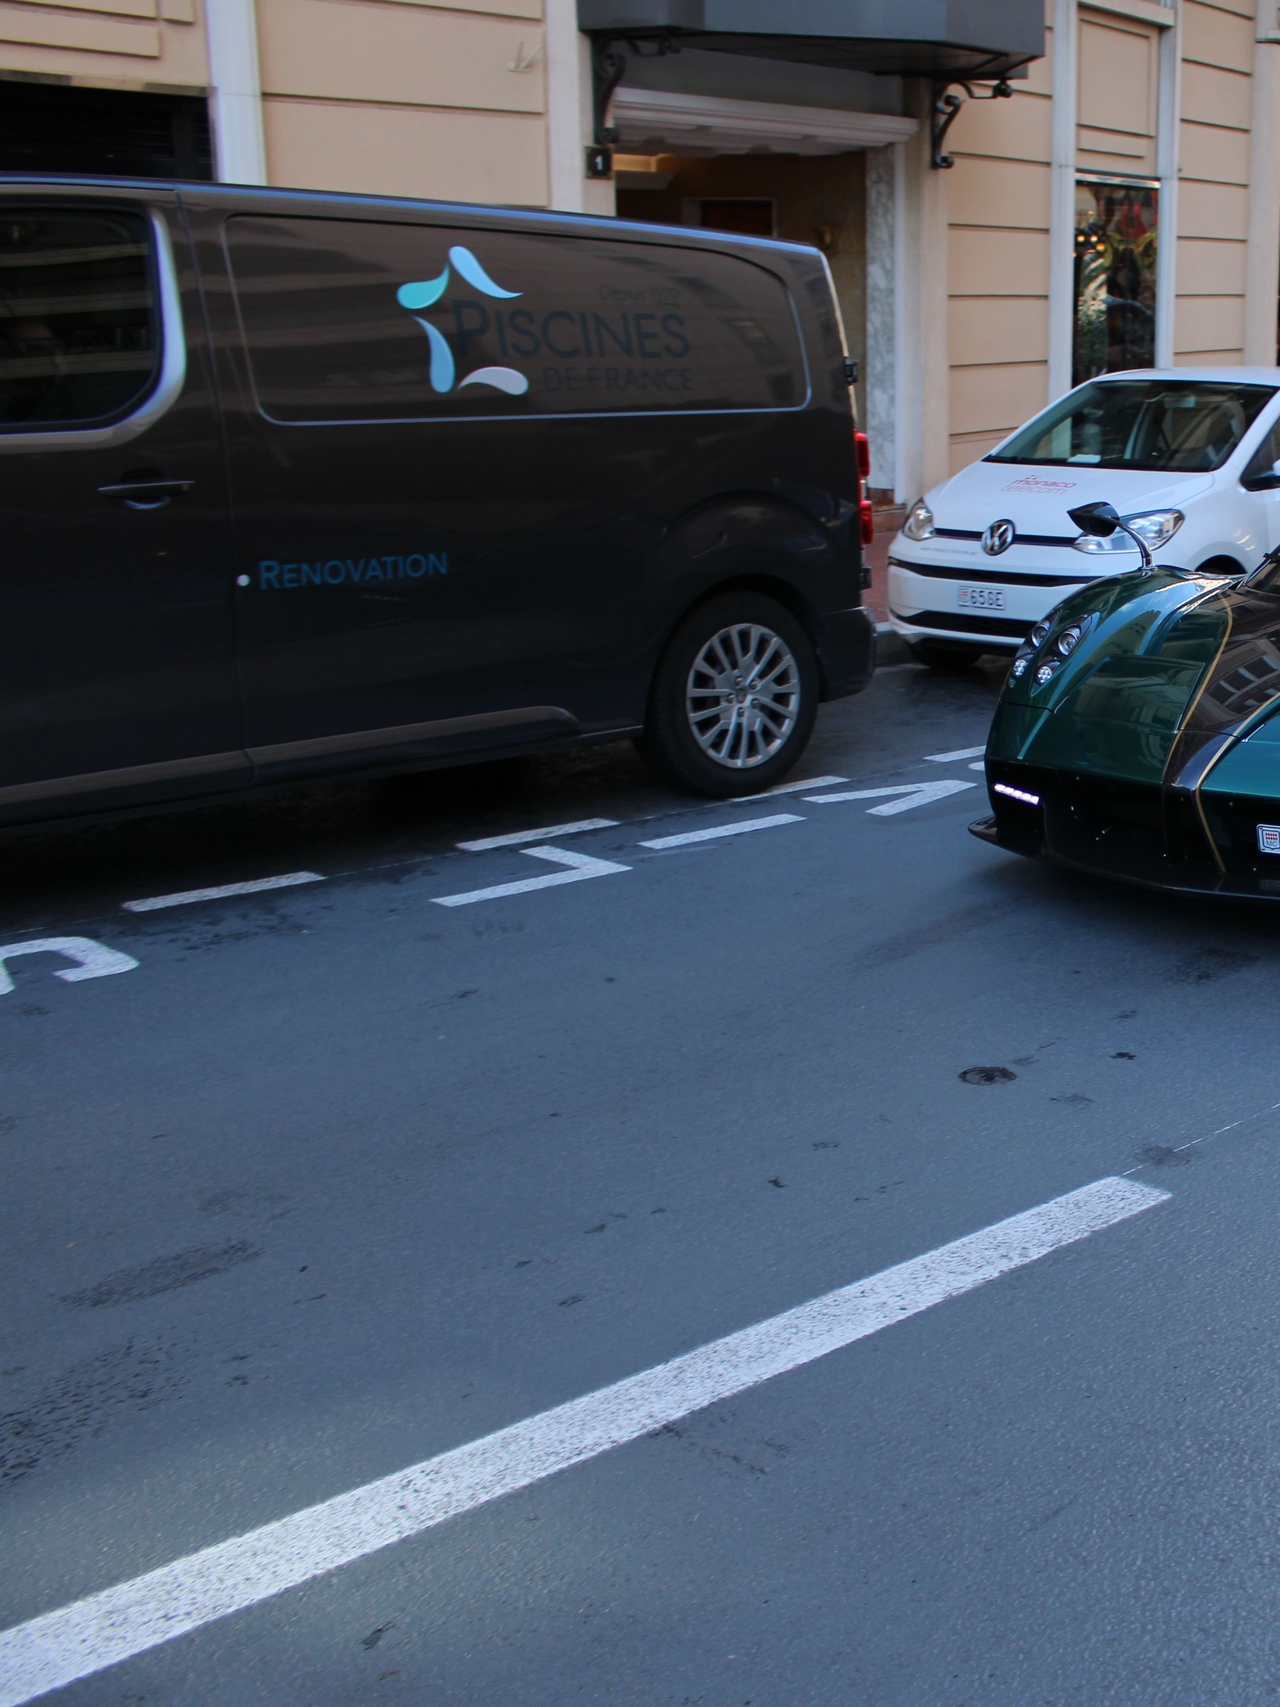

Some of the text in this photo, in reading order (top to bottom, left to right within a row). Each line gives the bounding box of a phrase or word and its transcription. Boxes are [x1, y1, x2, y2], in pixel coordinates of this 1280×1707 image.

[594, 155, 603, 170] 1
[452, 299, 690, 359] PISCINES
[543, 367, 694, 392] DE FRANCE
[1010, 479, 1077, 489] monaco
[259, 552, 449, 590] RENOVATION
